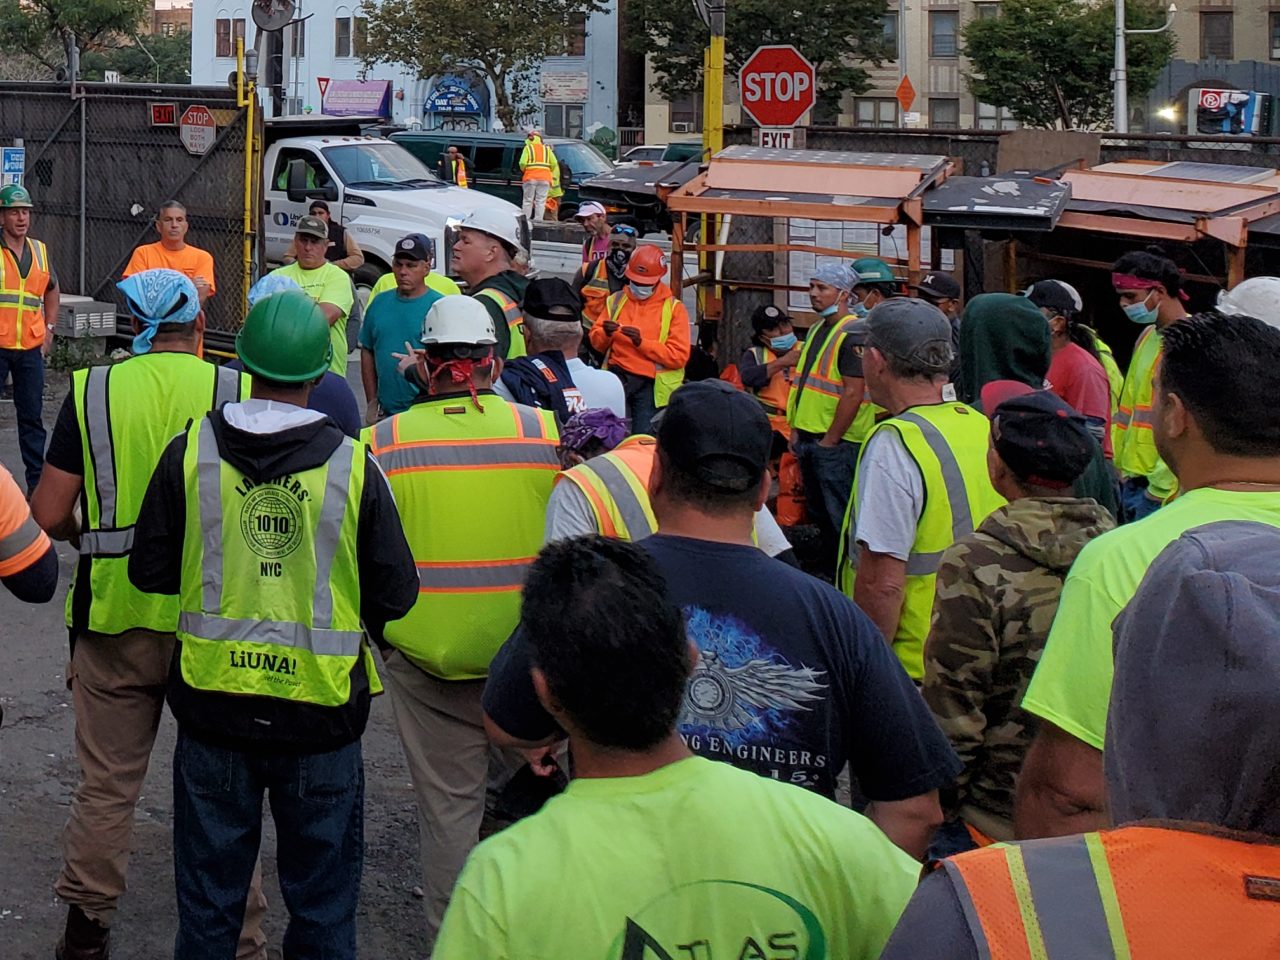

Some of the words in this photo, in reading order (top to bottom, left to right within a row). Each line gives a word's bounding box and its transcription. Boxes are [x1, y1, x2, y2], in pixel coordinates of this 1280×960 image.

[745, 71, 810, 102] STOP
[154, 107, 173, 122] EXIT
[188, 111, 209, 124] STOP
[761, 132, 791, 149] EXIT
[235, 475, 312, 502] LAERS'
[255, 514, 289, 534] 1010
[260, 561, 282, 577] NYC
[229, 650, 296, 675] LiUNA!
[709, 736, 827, 768] ENGINEERS
